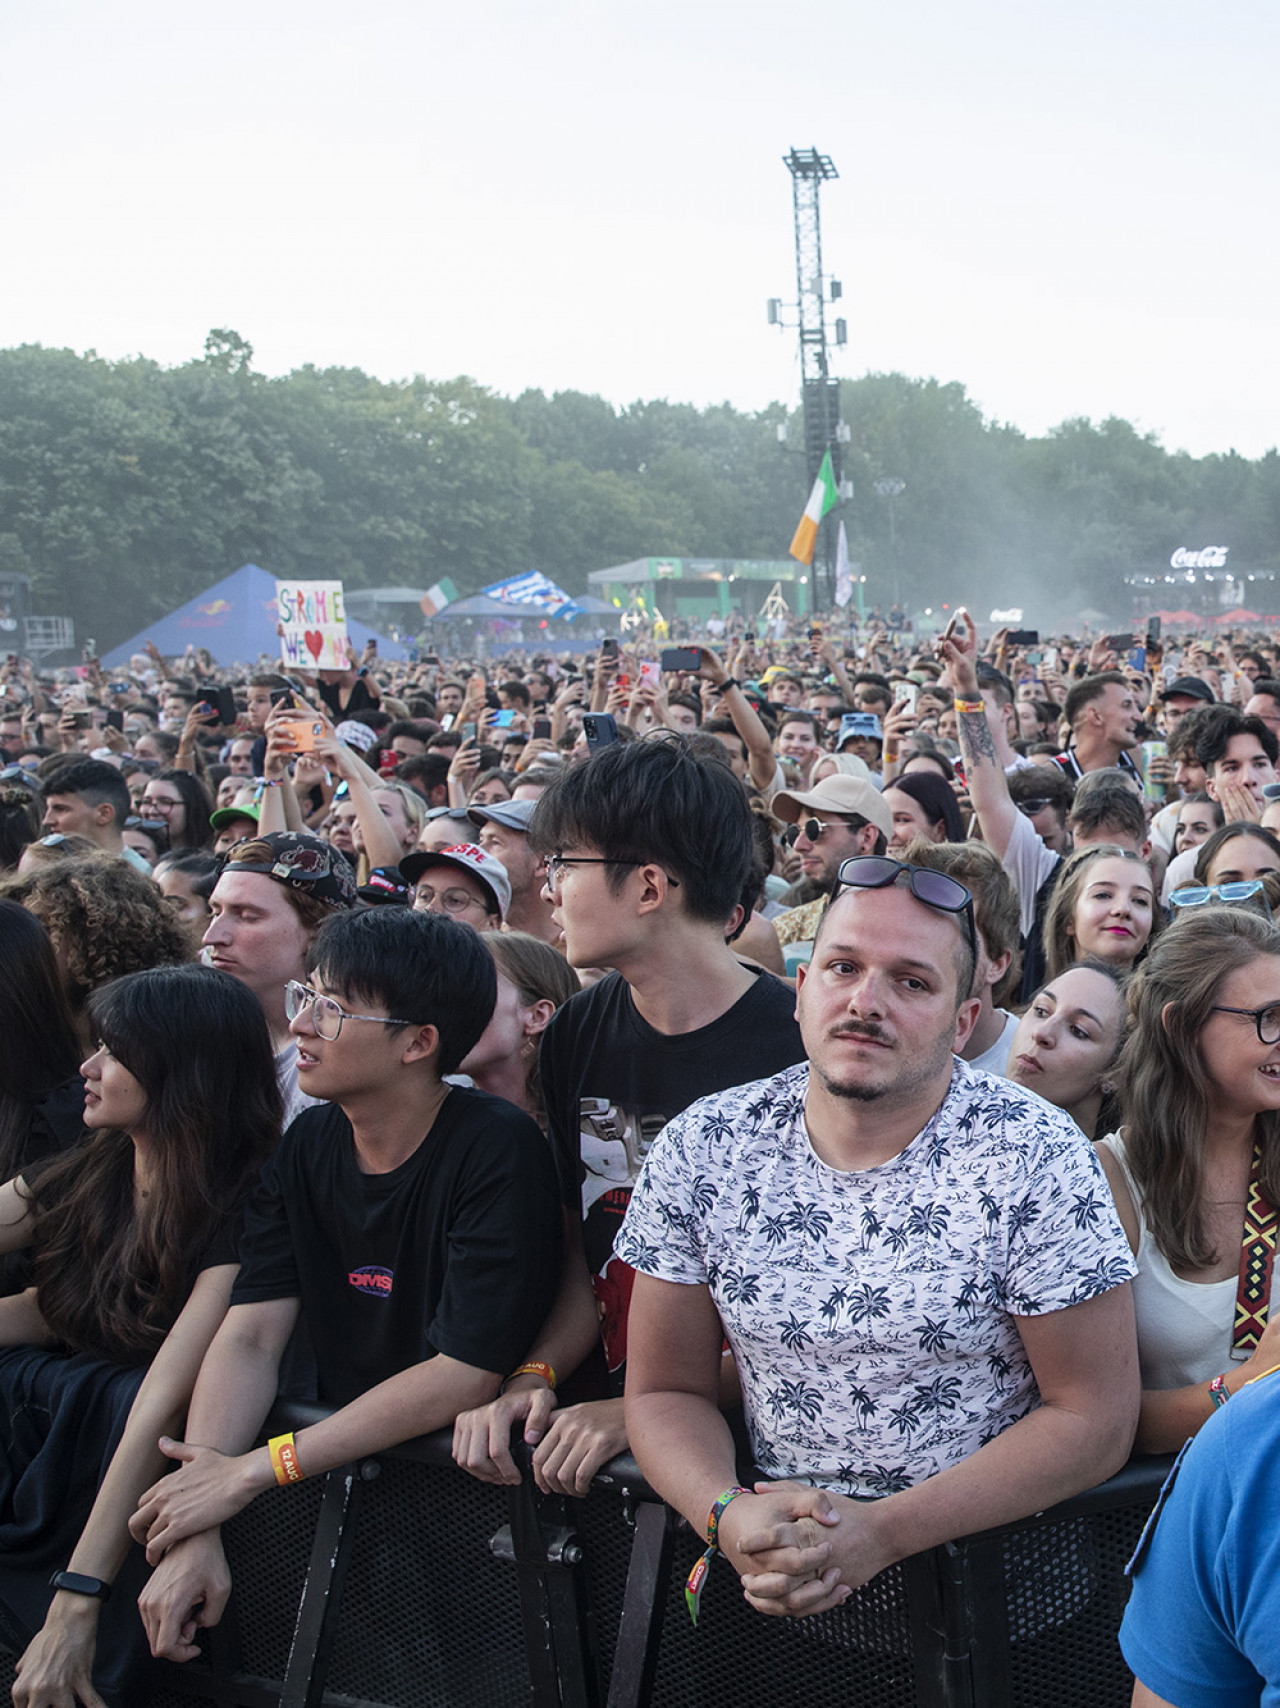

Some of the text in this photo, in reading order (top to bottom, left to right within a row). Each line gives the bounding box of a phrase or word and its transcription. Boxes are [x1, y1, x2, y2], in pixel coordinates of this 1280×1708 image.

[282, 632, 307, 665] WE
[282, 1449, 299, 1481] 12 AUG
